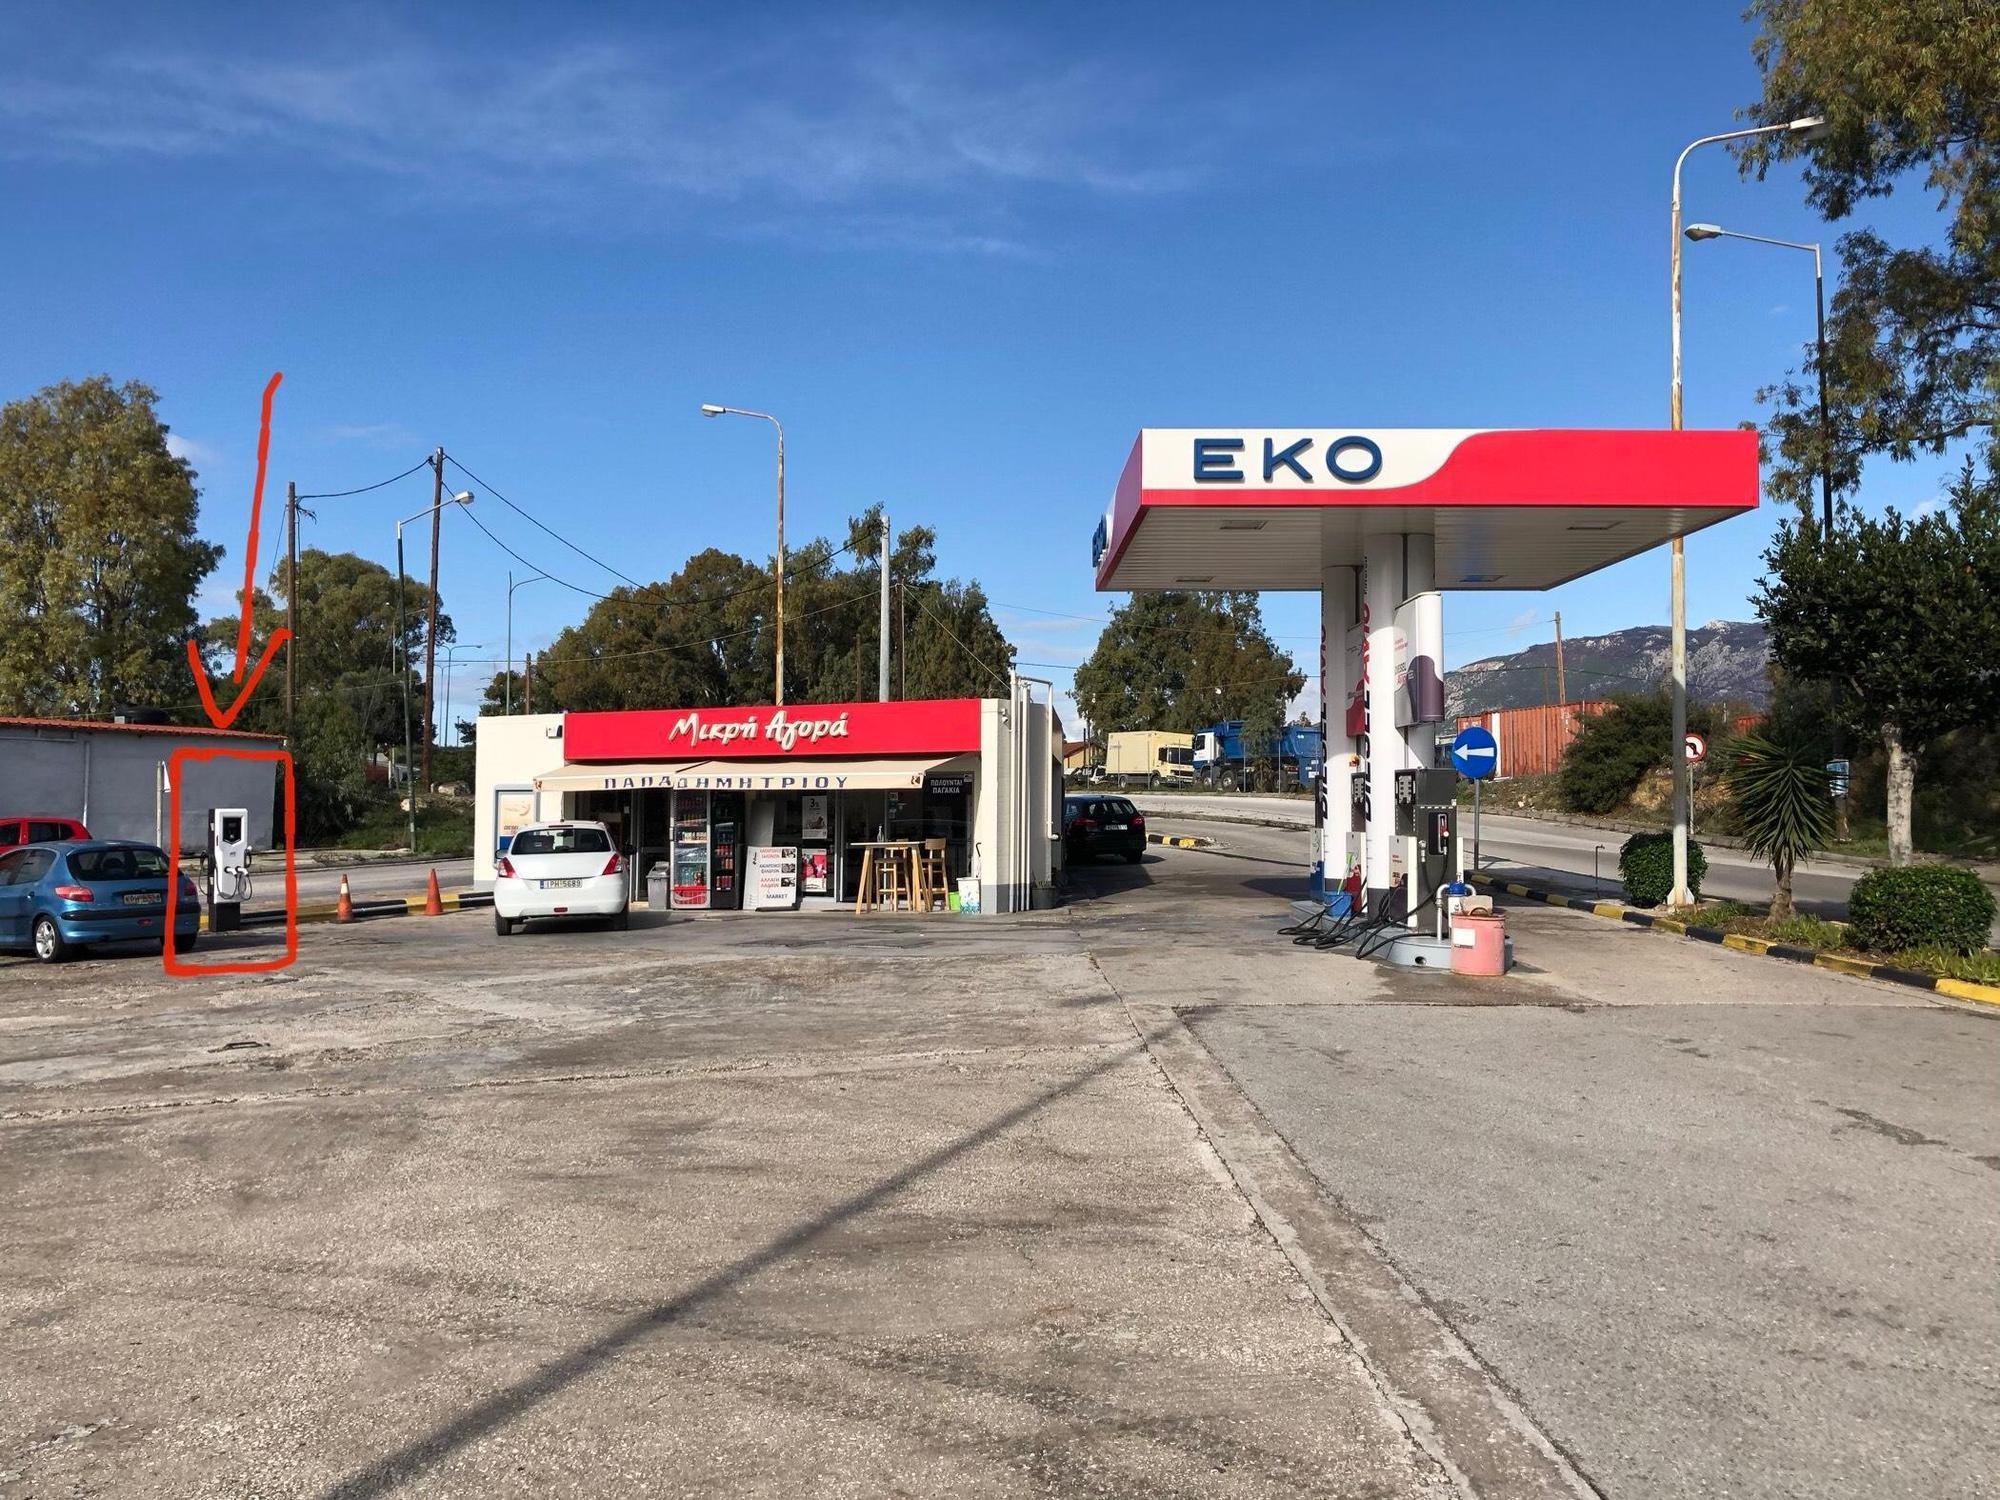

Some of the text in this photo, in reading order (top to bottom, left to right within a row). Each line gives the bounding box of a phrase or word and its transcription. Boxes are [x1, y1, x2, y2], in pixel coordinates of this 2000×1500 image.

[1194, 435, 1382, 482] EKO
[668, 710, 849, 751] Μικρή Αγορά
[603, 775, 848, 790] ΠΑΠΑΔΗΜΗΤΡΙΟΥ
